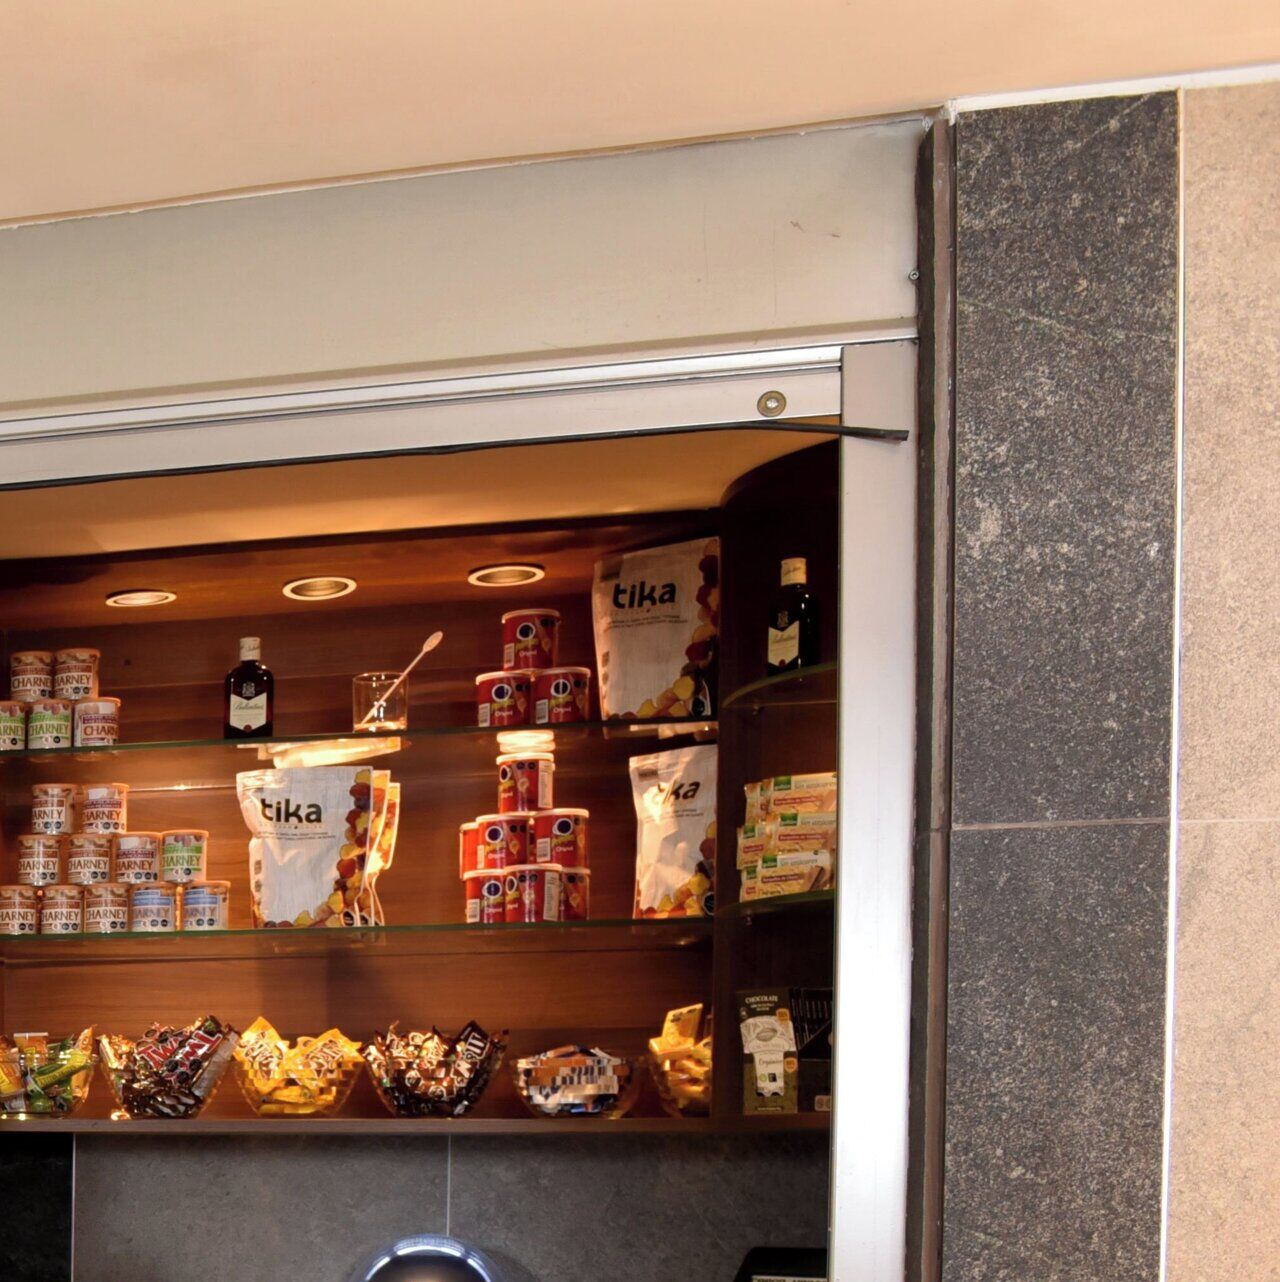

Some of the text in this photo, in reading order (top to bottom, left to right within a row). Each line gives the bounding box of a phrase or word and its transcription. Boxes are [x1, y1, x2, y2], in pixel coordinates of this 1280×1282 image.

[612, 581, 677, 609] tika
[12, 677, 52, 689] CHARNE
[657, 780, 701, 803] ka
[260, 798, 322, 824] tika
